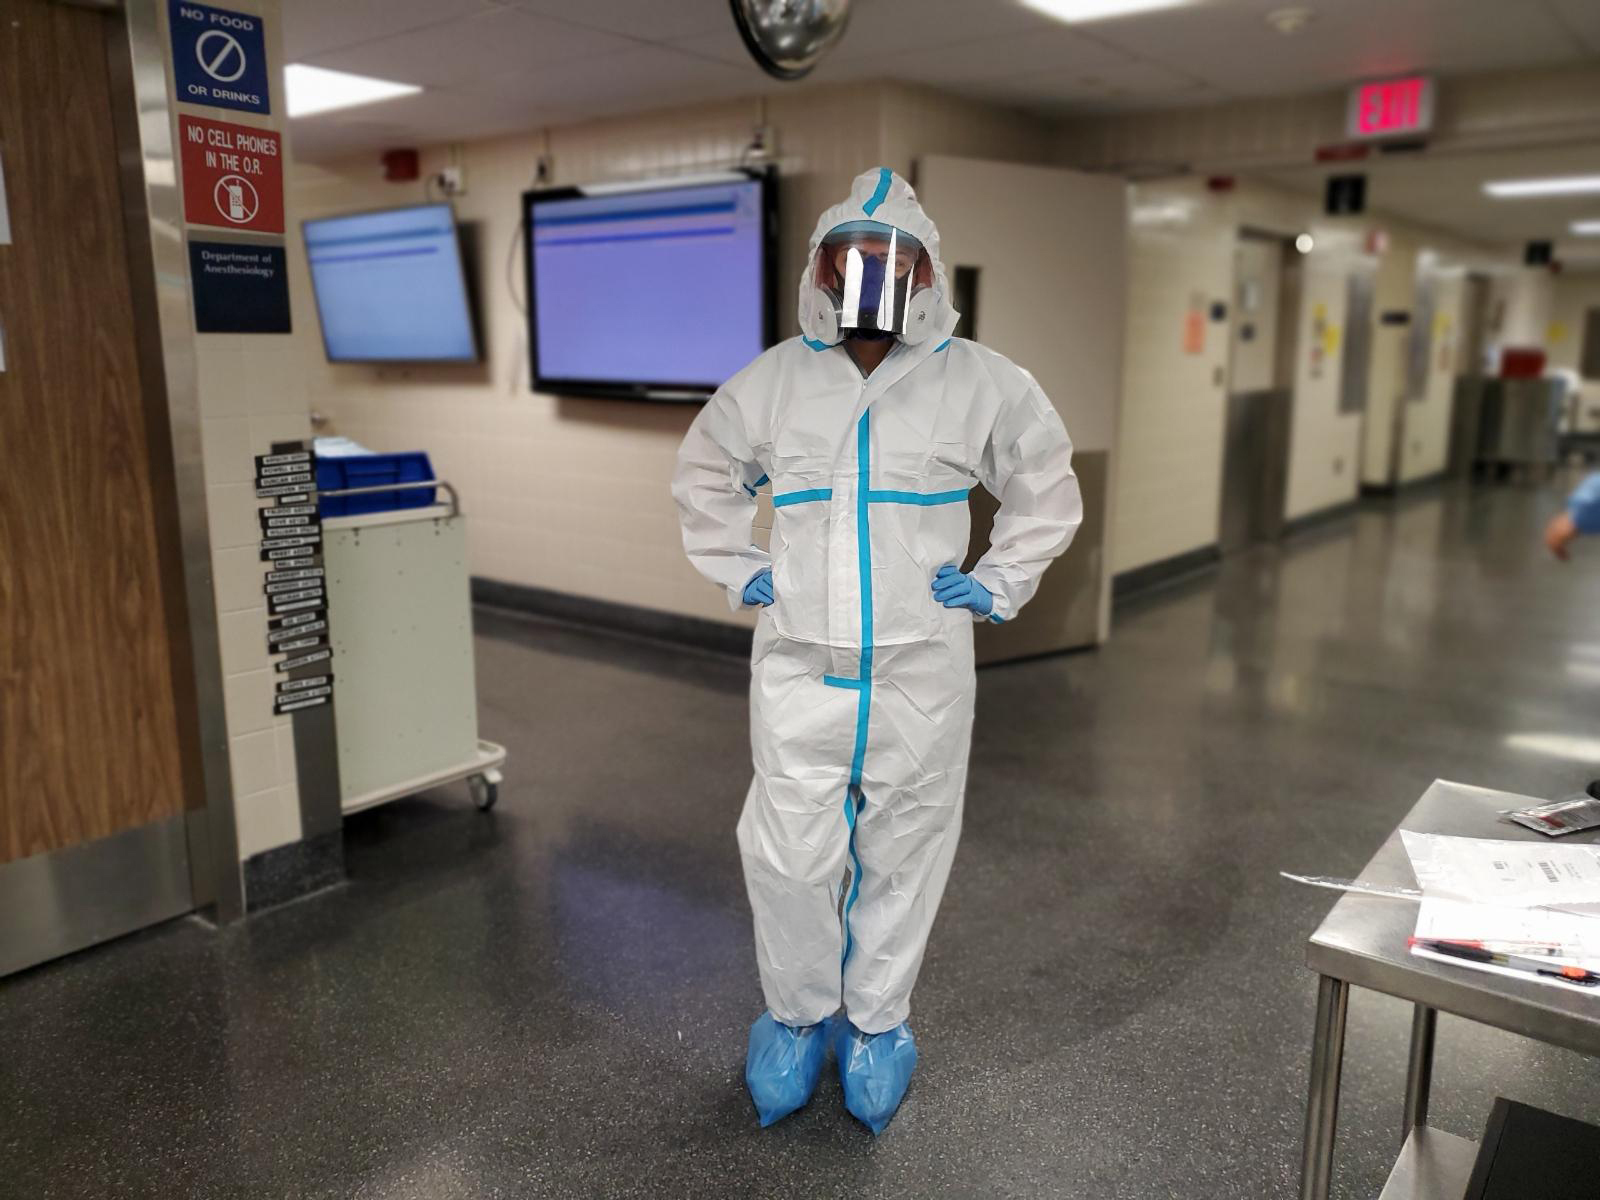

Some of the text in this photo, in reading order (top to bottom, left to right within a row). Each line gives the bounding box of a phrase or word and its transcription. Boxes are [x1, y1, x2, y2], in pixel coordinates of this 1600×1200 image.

[180, 7, 254, 31] NO FOOD
[187, 84, 260, 105] OR DRINKS
[187, 124, 277, 156] NO CELL PHONES
[205, 150, 263, 175] IN THE O.R.
[201, 250, 273, 263] Department of
[203, 264, 274, 278] Anesthesiology
